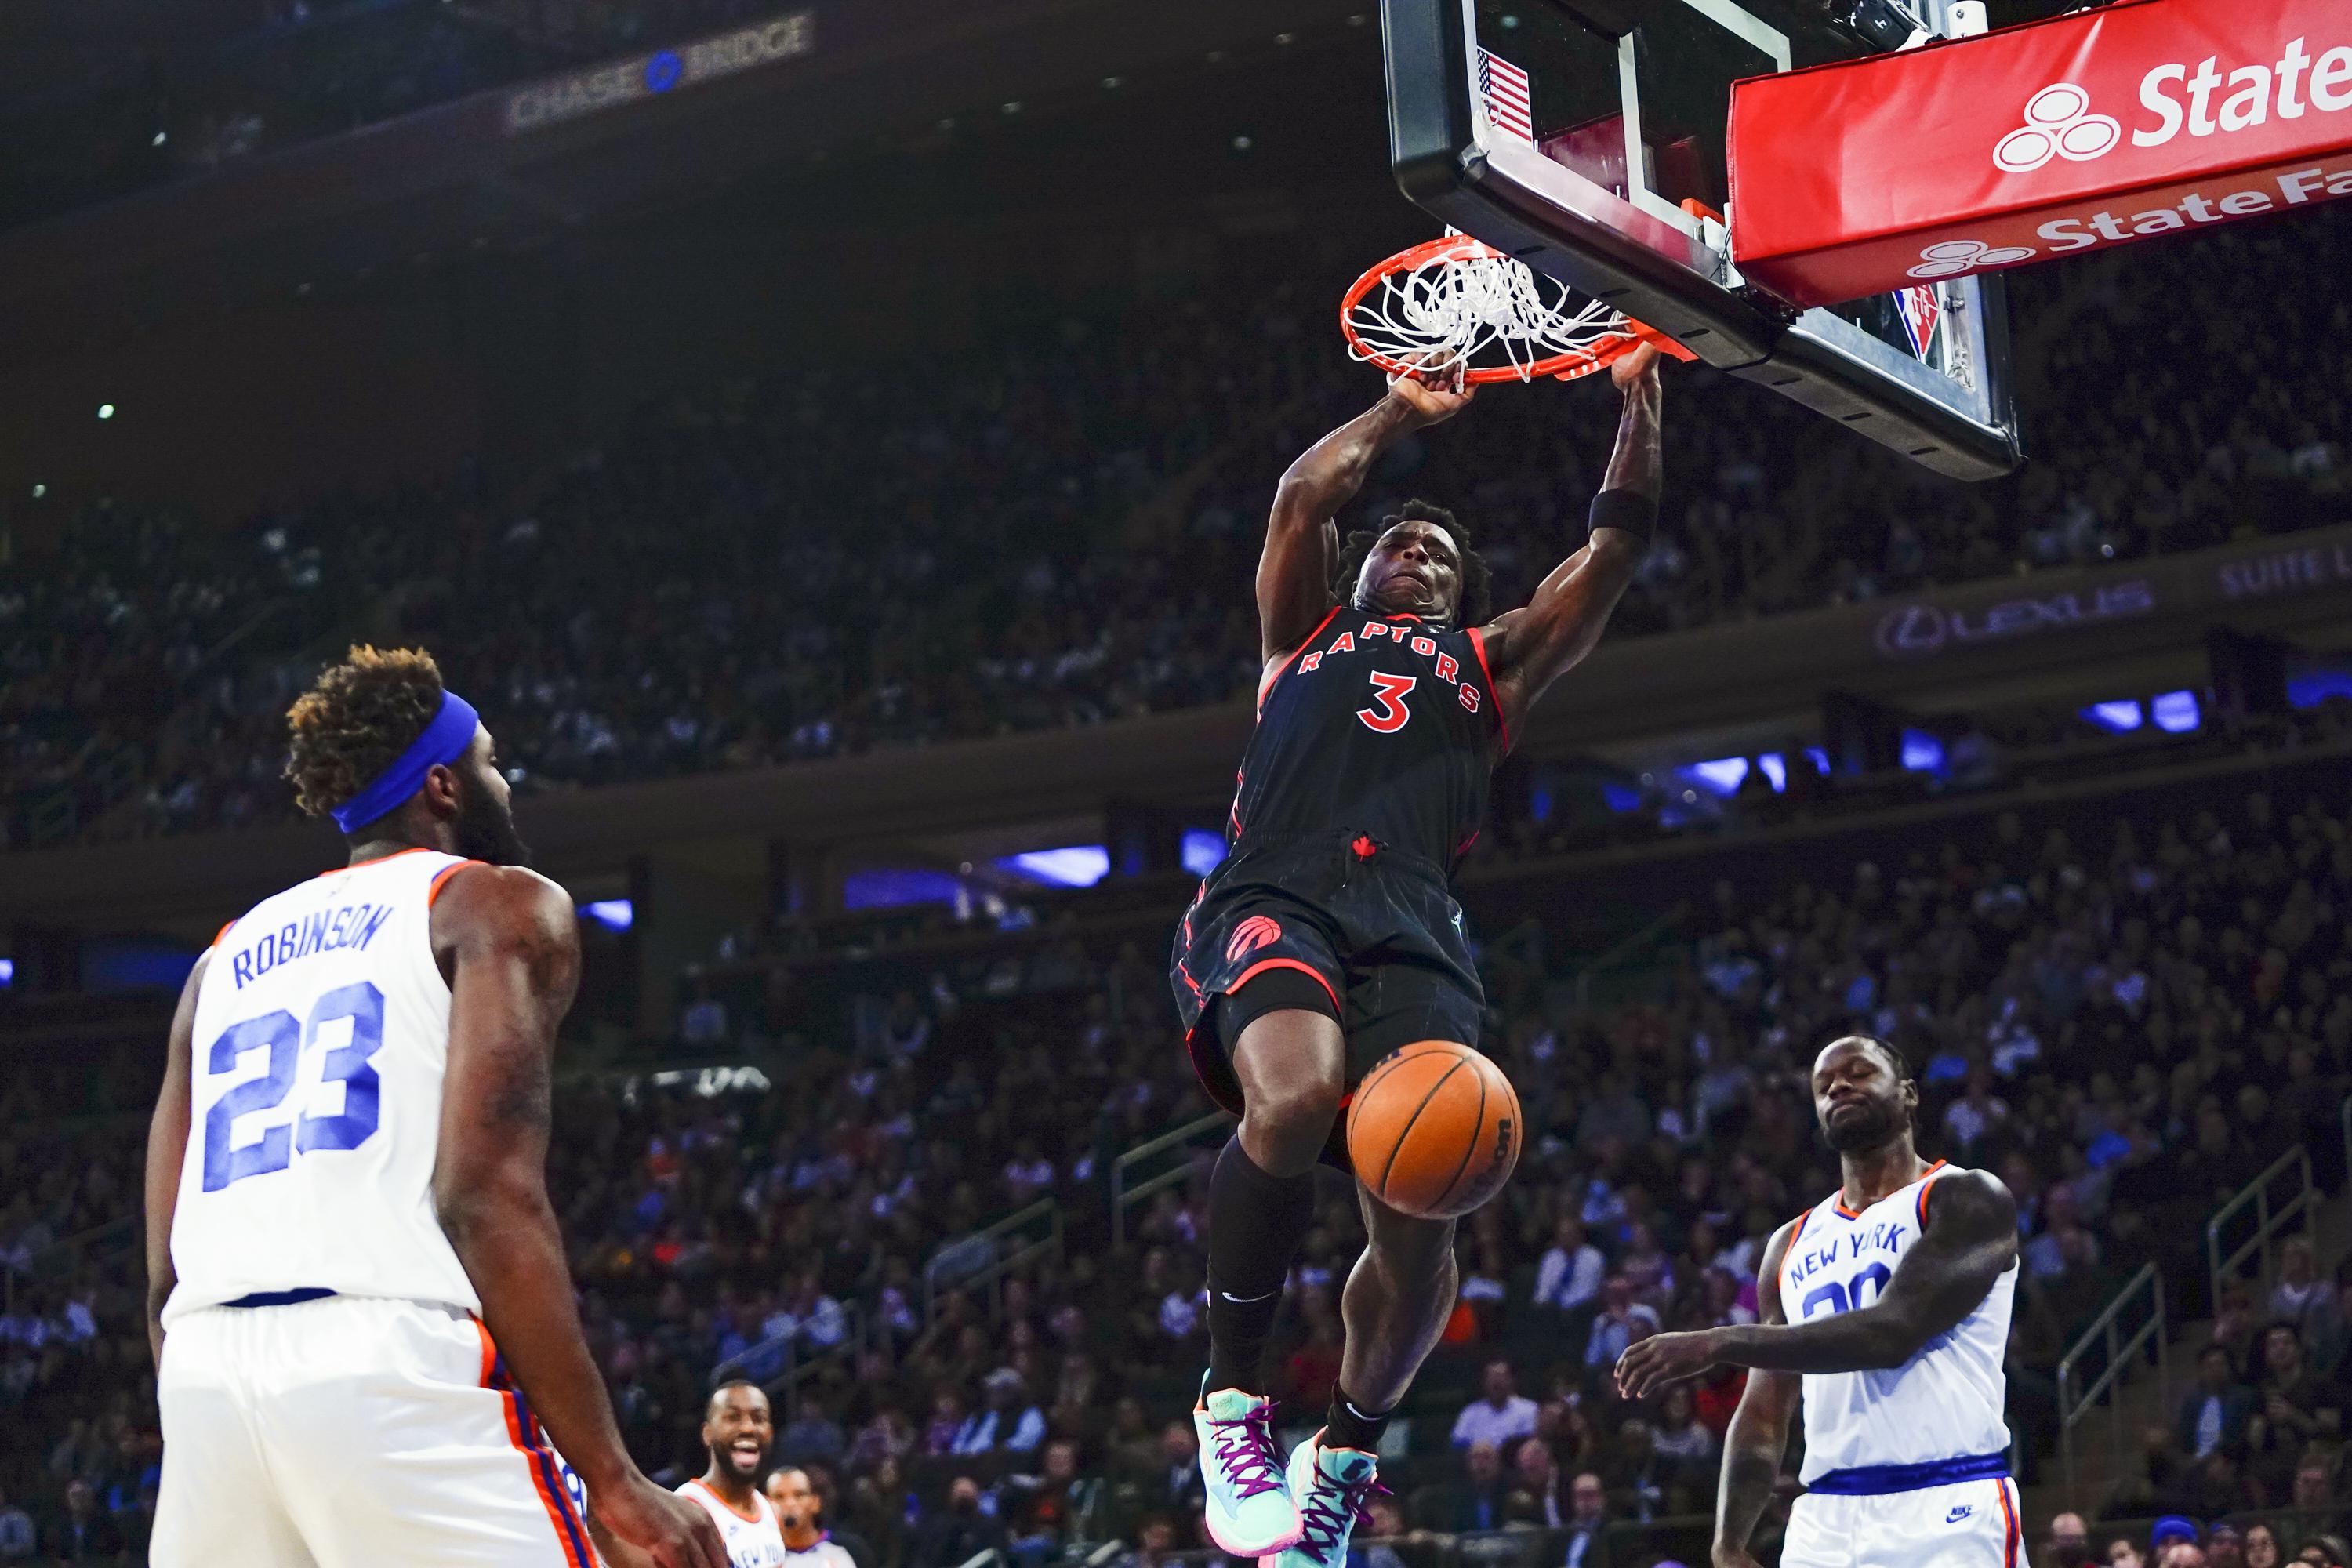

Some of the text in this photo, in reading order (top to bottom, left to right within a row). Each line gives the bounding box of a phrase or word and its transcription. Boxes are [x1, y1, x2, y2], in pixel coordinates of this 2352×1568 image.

[2132, 36, 2352, 147] State
[2037, 191, 2274, 252] State
[1951, 579, 2154, 637] LEXUS
[1298, 621, 1480, 713] RAPTORS
[1356, 670, 1417, 733] 3
[233, 903, 394, 989] ROBINSON
[203, 980, 385, 1192] 23
[1791, 1240, 1838, 1289] NEW
